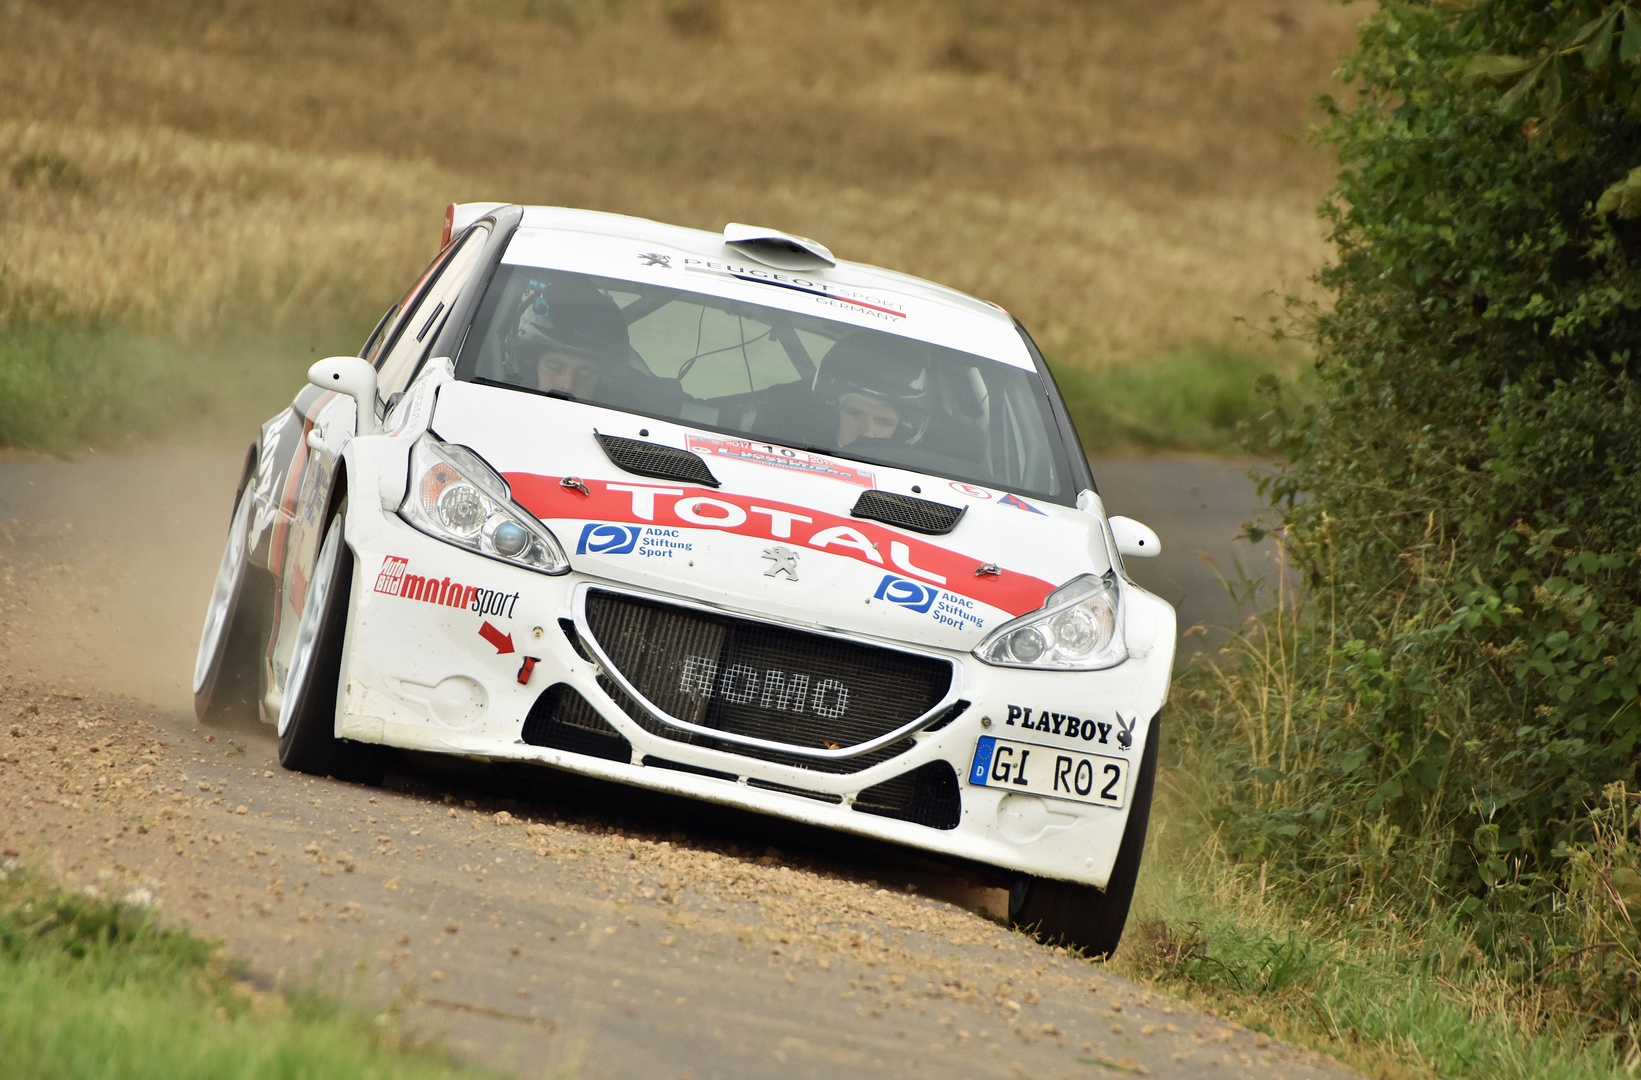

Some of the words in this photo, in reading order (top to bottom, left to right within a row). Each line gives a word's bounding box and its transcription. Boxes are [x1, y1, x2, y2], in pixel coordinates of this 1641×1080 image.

[685, 259, 837, 291] PEUGEOT
[839, 289, 906, 311] SPORT
[815, 298, 899, 323] GERMANY
[762, 445, 796, 458] 10
[606, 483, 947, 585] TOTAL
[645, 527, 680, 538] ADAC
[639, 546, 673, 558] Sport
[642, 537, 693, 551] Stiftung
[381, 556, 408, 577] Auto
[376, 575, 401, 596] Bild
[941, 592, 974, 609] ADAC
[932, 609, 964, 631] Sport
[937, 601, 984, 628] Stiftung
[679, 655, 850, 718] ROMO
[1006, 704, 1113, 744] PLAYBOY
[976, 766, 985, 777] D
[991, 746, 1030, 786] GI
